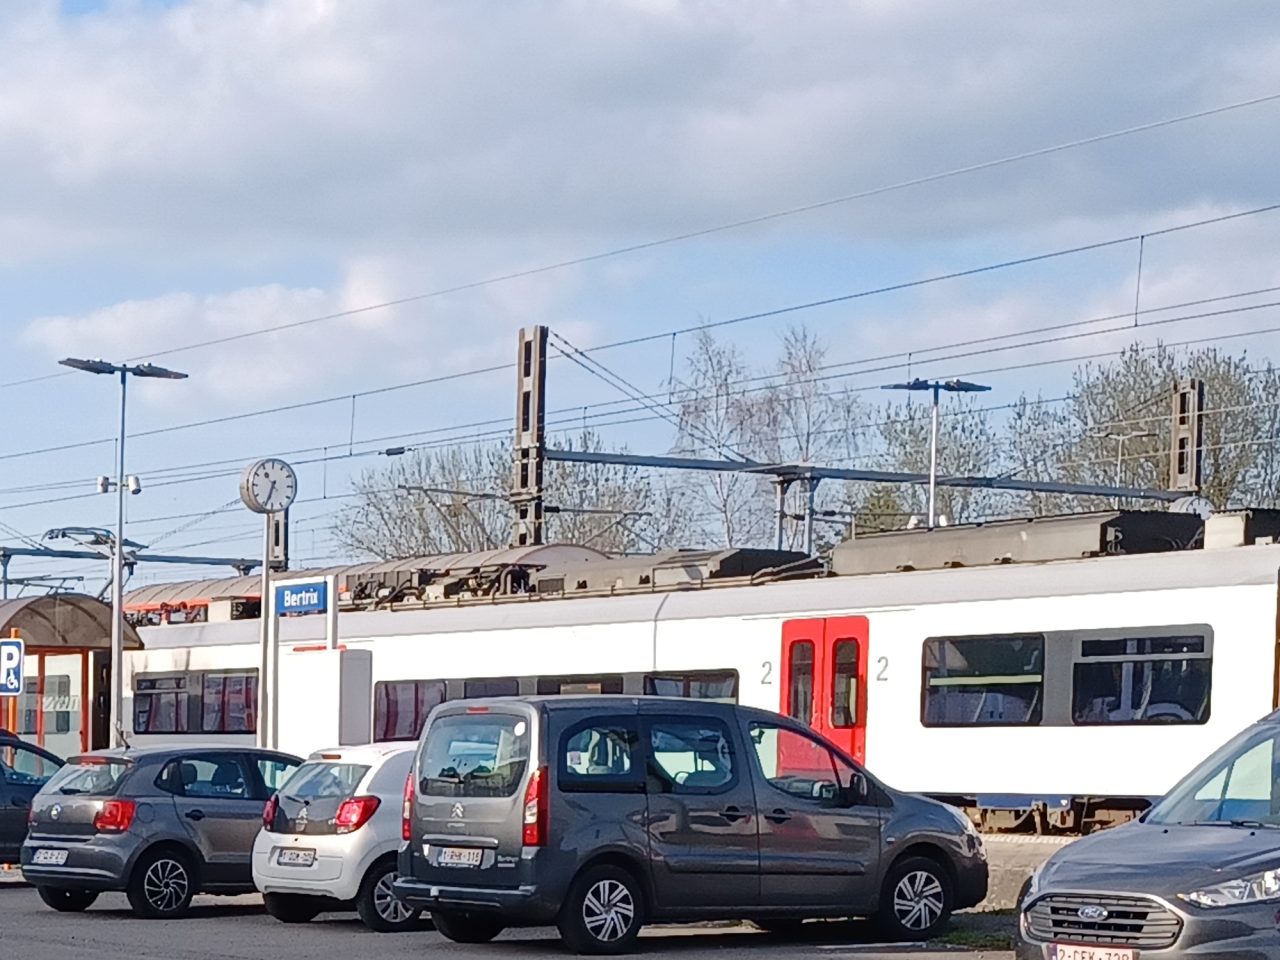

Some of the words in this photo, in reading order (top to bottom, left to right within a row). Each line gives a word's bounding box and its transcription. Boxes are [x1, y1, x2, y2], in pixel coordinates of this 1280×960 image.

[284, 588, 319, 607] Bertrix
[0, 645, 20, 684] P
[761, 661, 773, 685] 2
[876, 656, 889, 681] 2
